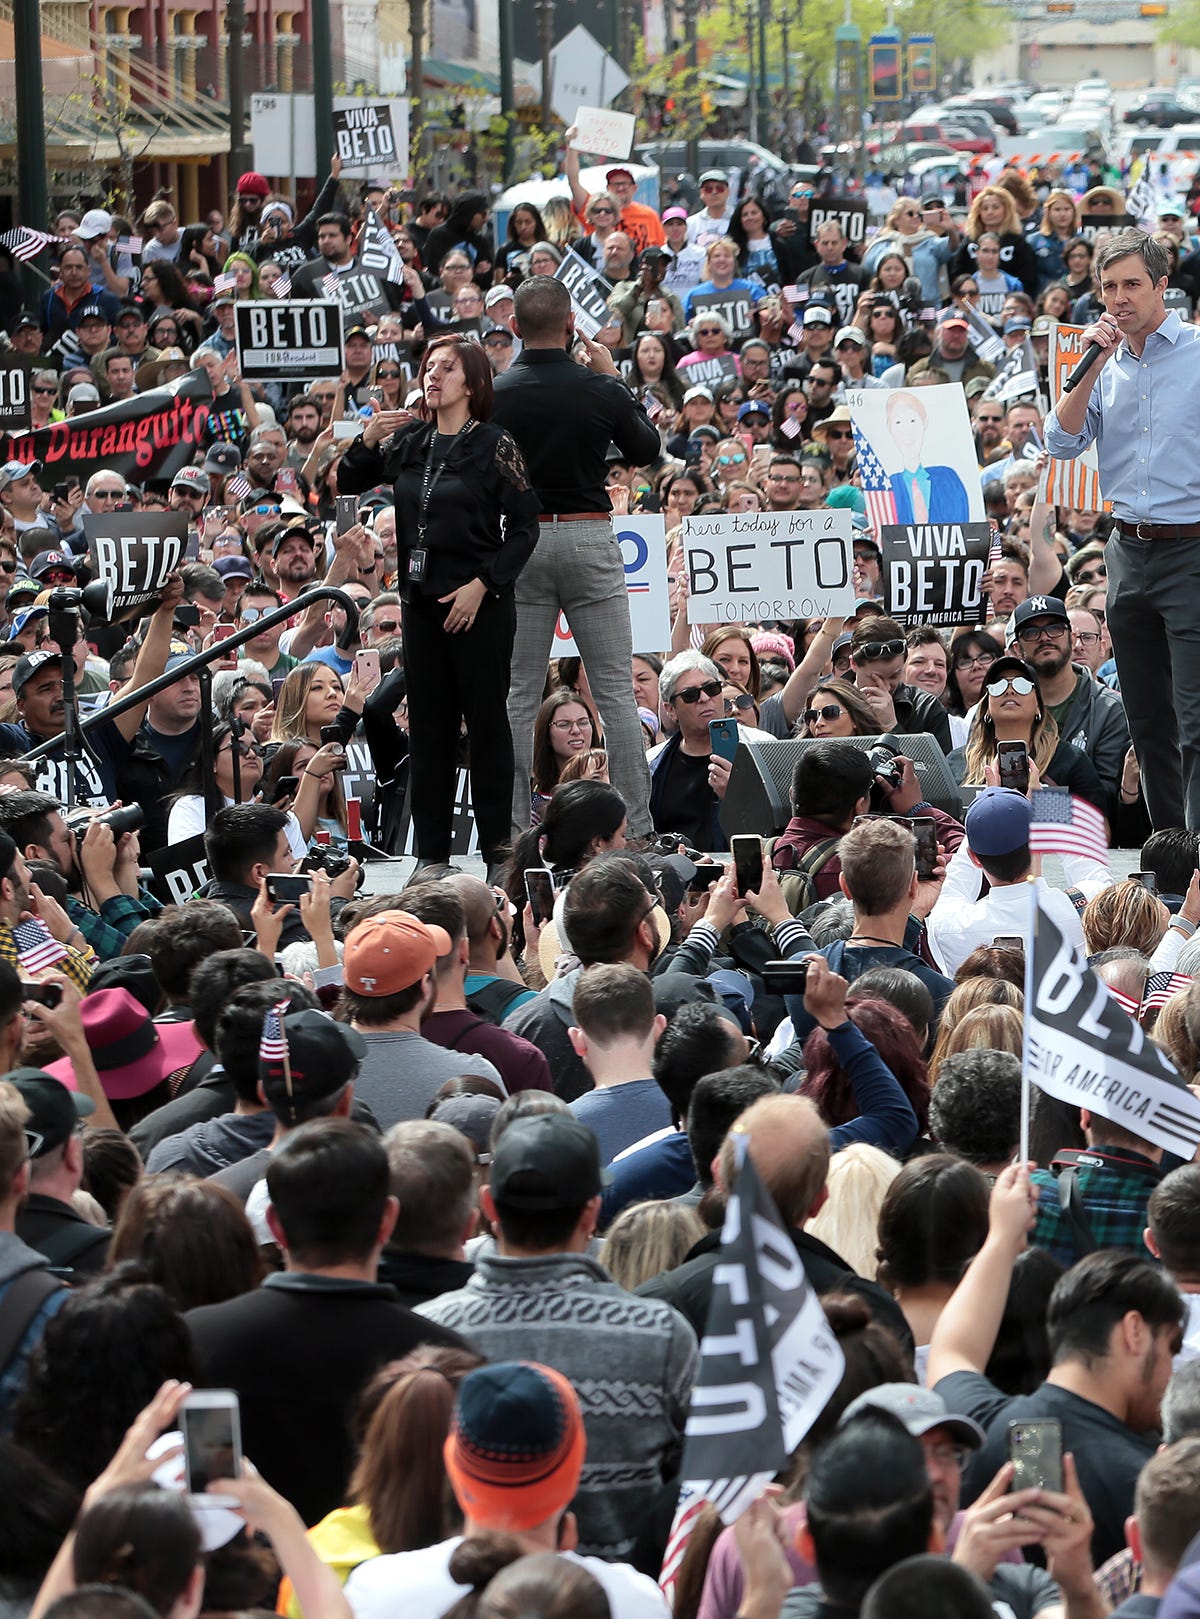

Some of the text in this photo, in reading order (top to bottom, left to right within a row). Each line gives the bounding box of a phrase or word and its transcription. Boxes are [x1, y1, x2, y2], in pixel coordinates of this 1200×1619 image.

[345, 107, 379, 129] VIVA
[337, 125, 393, 160] BETO
[562, 263, 607, 317] BETO
[250, 307, 327, 348] BETO
[686, 358, 723, 384] VIVA
[849, 393, 864, 408] 46
[45, 397, 210, 468] Duranguito
[685, 515, 836, 538] here today for a
[906, 525, 967, 558] VIVA
[688, 537, 849, 596] BETO
[114, 595, 125, 607] FOR
[890, 559, 985, 613] BETO
[710, 598, 833, 622] TOMORROW
[907, 610, 963, 626] FOR AMERICA
[1064, 1063, 1152, 1119] AMERICA
